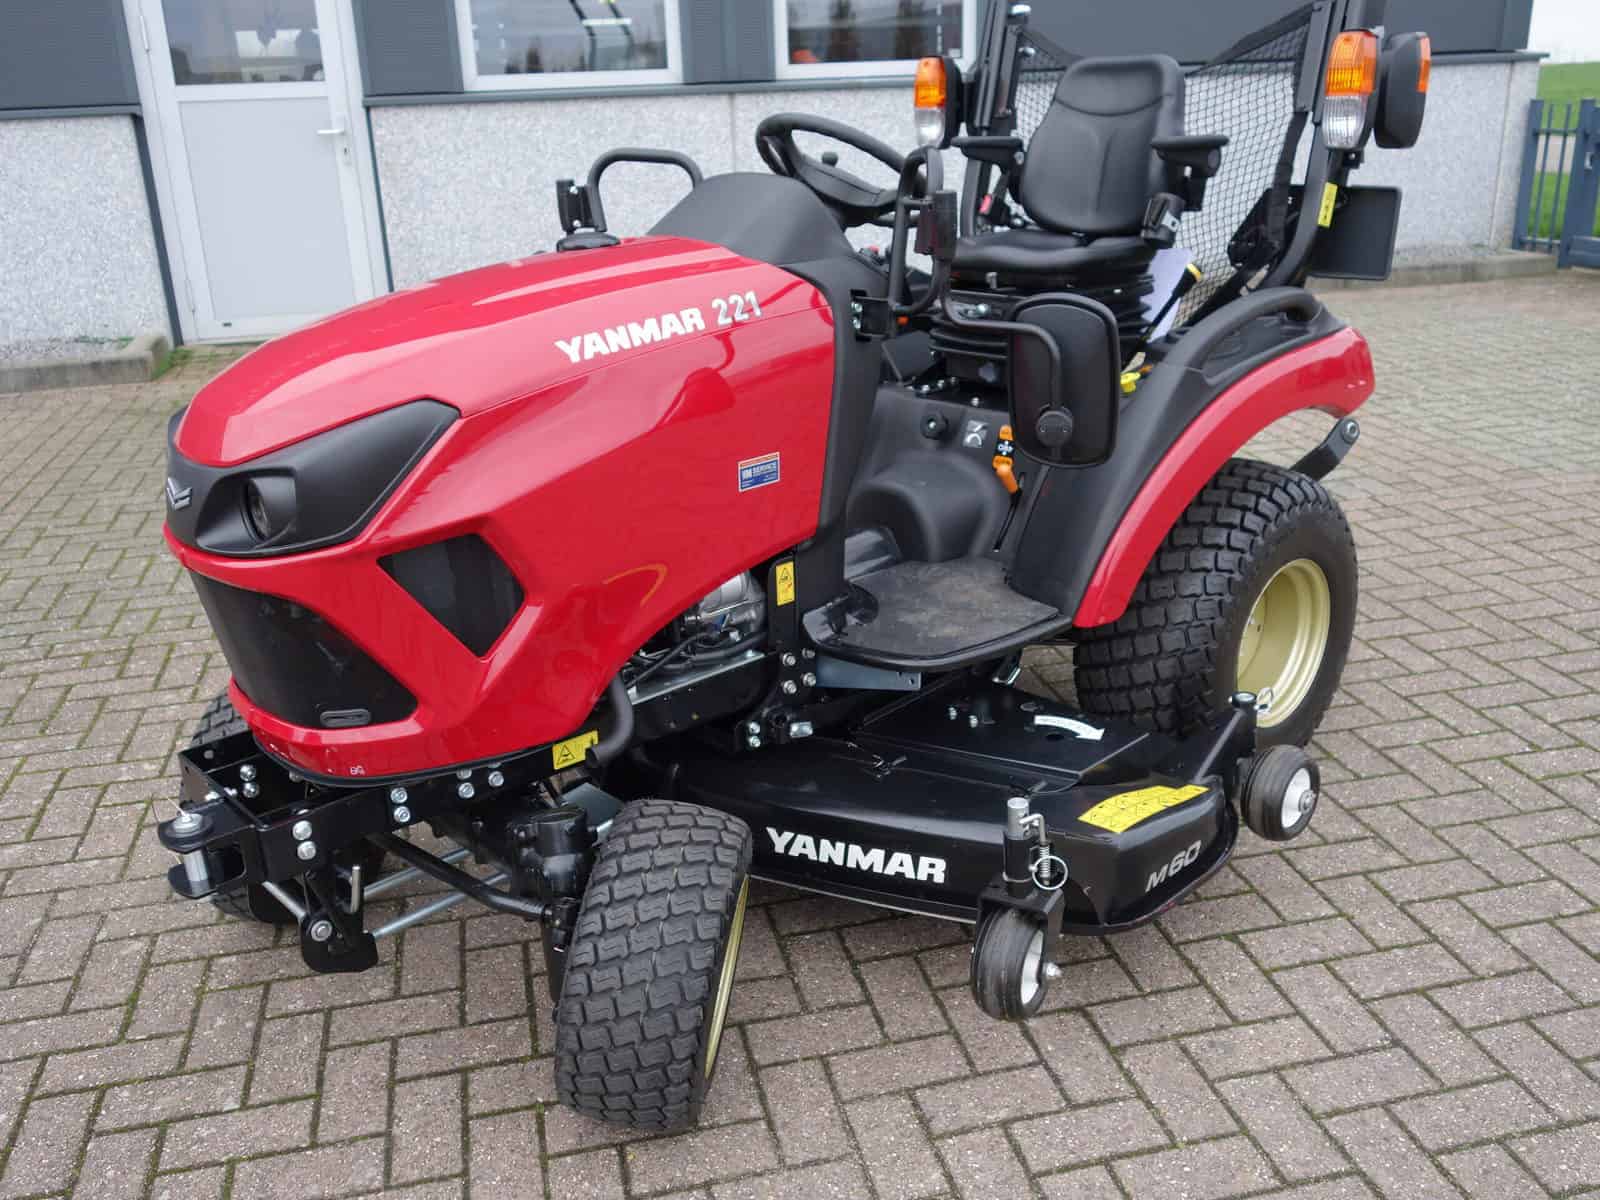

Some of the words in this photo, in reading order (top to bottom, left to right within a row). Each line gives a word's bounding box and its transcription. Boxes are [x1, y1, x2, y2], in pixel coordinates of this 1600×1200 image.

[554, 307, 706, 363] YANMAR
[711, 290, 762, 326] 221
[766, 826, 946, 884] YANMAR
[1145, 840, 1202, 893] M60
